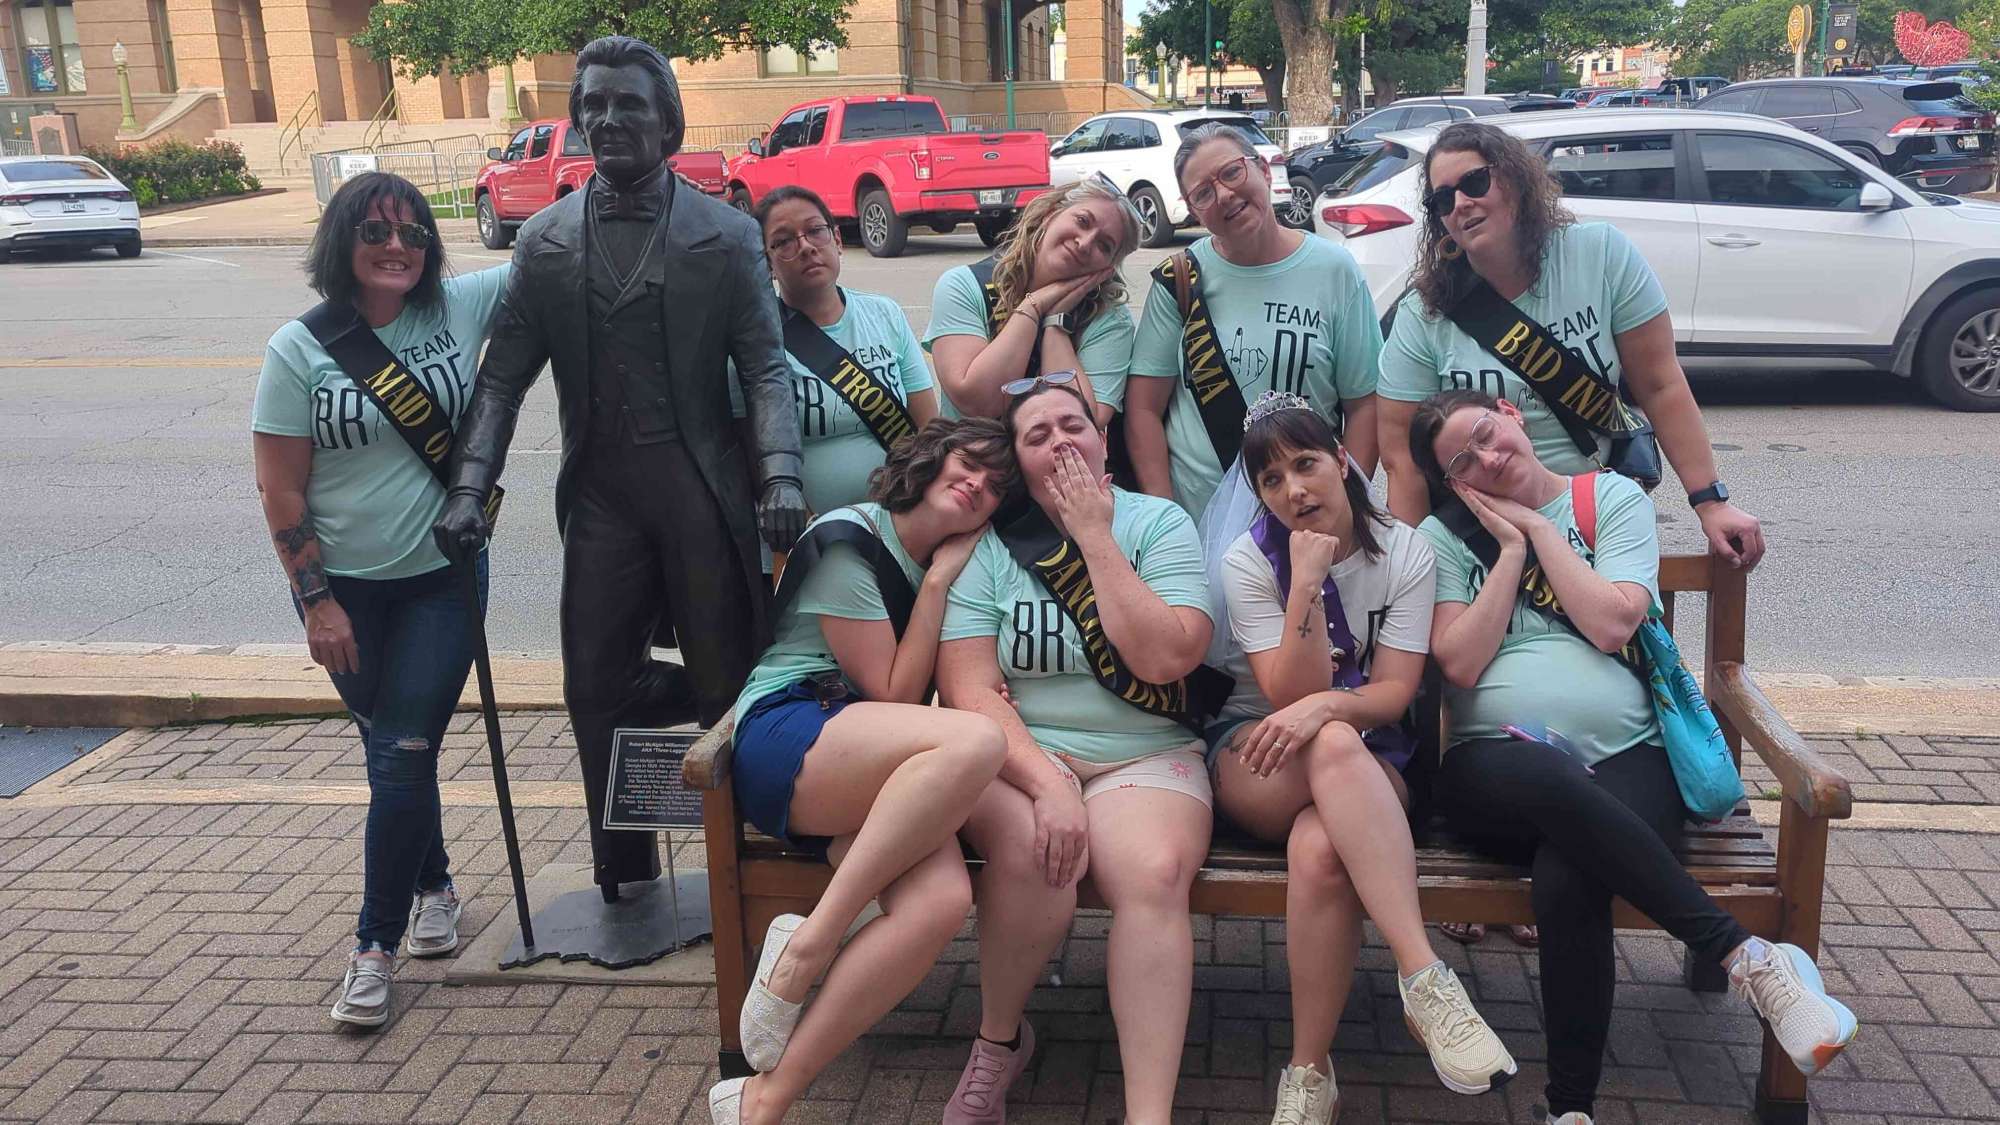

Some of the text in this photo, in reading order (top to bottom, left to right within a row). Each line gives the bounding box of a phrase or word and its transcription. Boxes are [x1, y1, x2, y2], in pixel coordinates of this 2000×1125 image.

[1263, 301, 1321, 330] TEAM
[1544, 305, 1599, 343] EAM
[400, 329, 458, 368] TEAM
[1494, 320, 1563, 383] BAD
[363, 361, 433, 427] MAID
